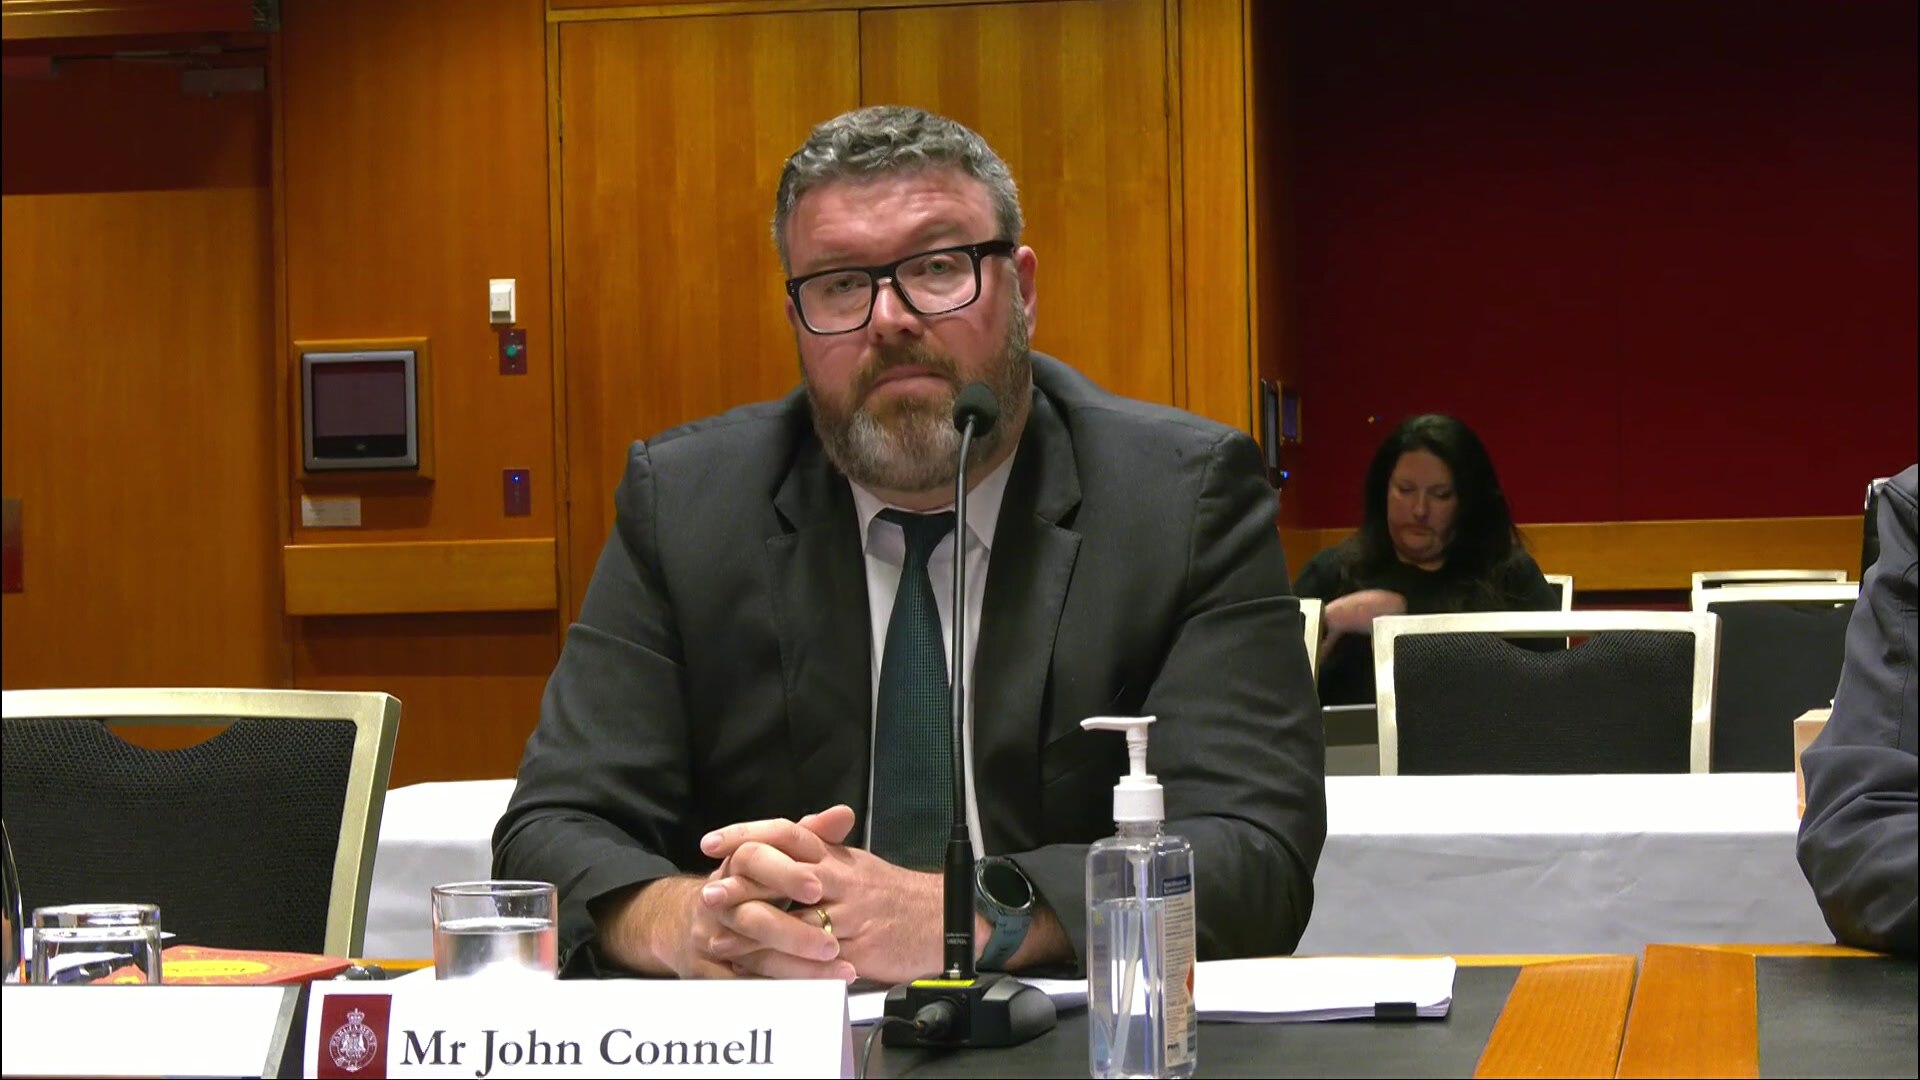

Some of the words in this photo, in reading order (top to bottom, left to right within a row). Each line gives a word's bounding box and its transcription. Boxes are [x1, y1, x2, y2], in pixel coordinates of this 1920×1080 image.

[400, 1030, 466, 1065] Mr
[475, 1029, 583, 1077] John
[600, 1028, 774, 1065] Connell
